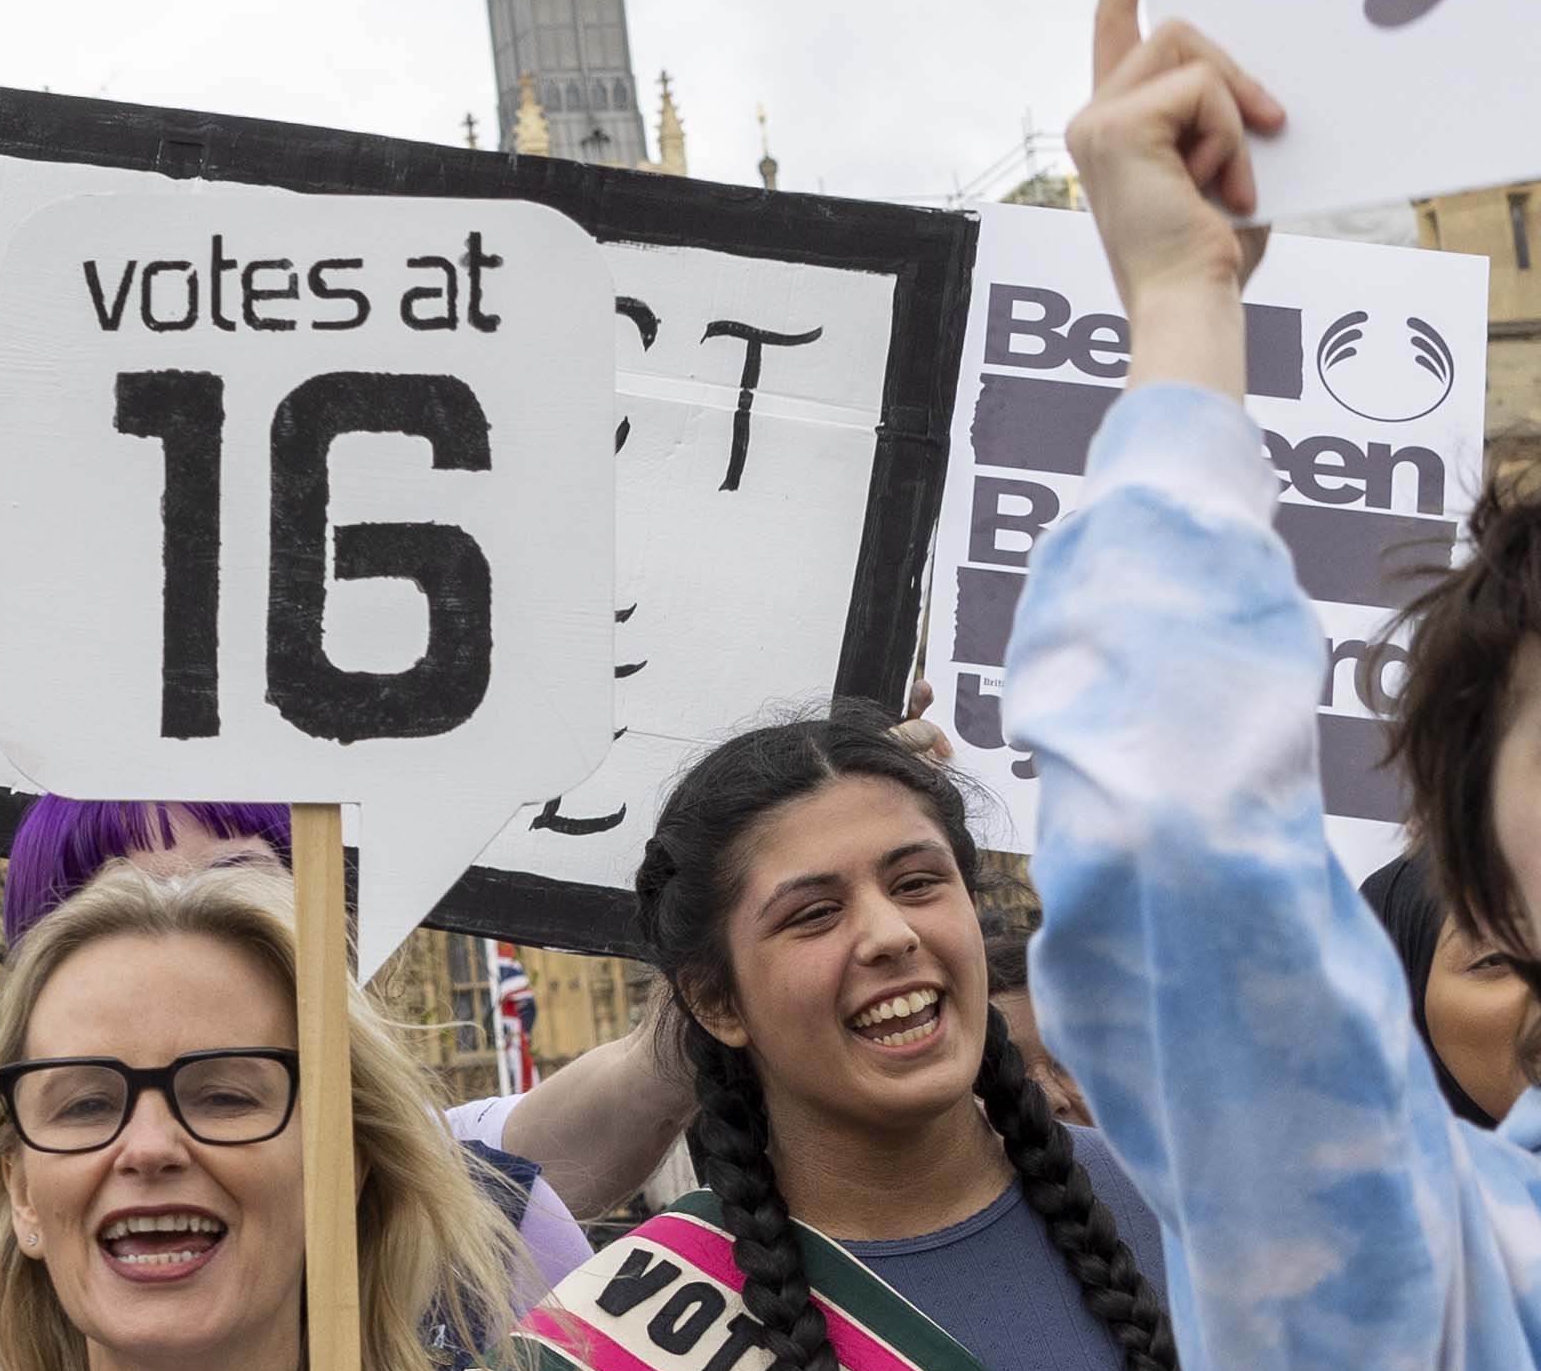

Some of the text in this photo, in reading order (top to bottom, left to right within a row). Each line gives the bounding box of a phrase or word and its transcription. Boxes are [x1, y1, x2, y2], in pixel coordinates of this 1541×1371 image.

[83, 234, 372, 335] votes
[400, 230, 503, 334] at
[984, 282, 1132, 379] Be
[1266, 428, 1445, 516] en
[112, 369, 493, 743] 16
[968, 475, 1079, 567] B
